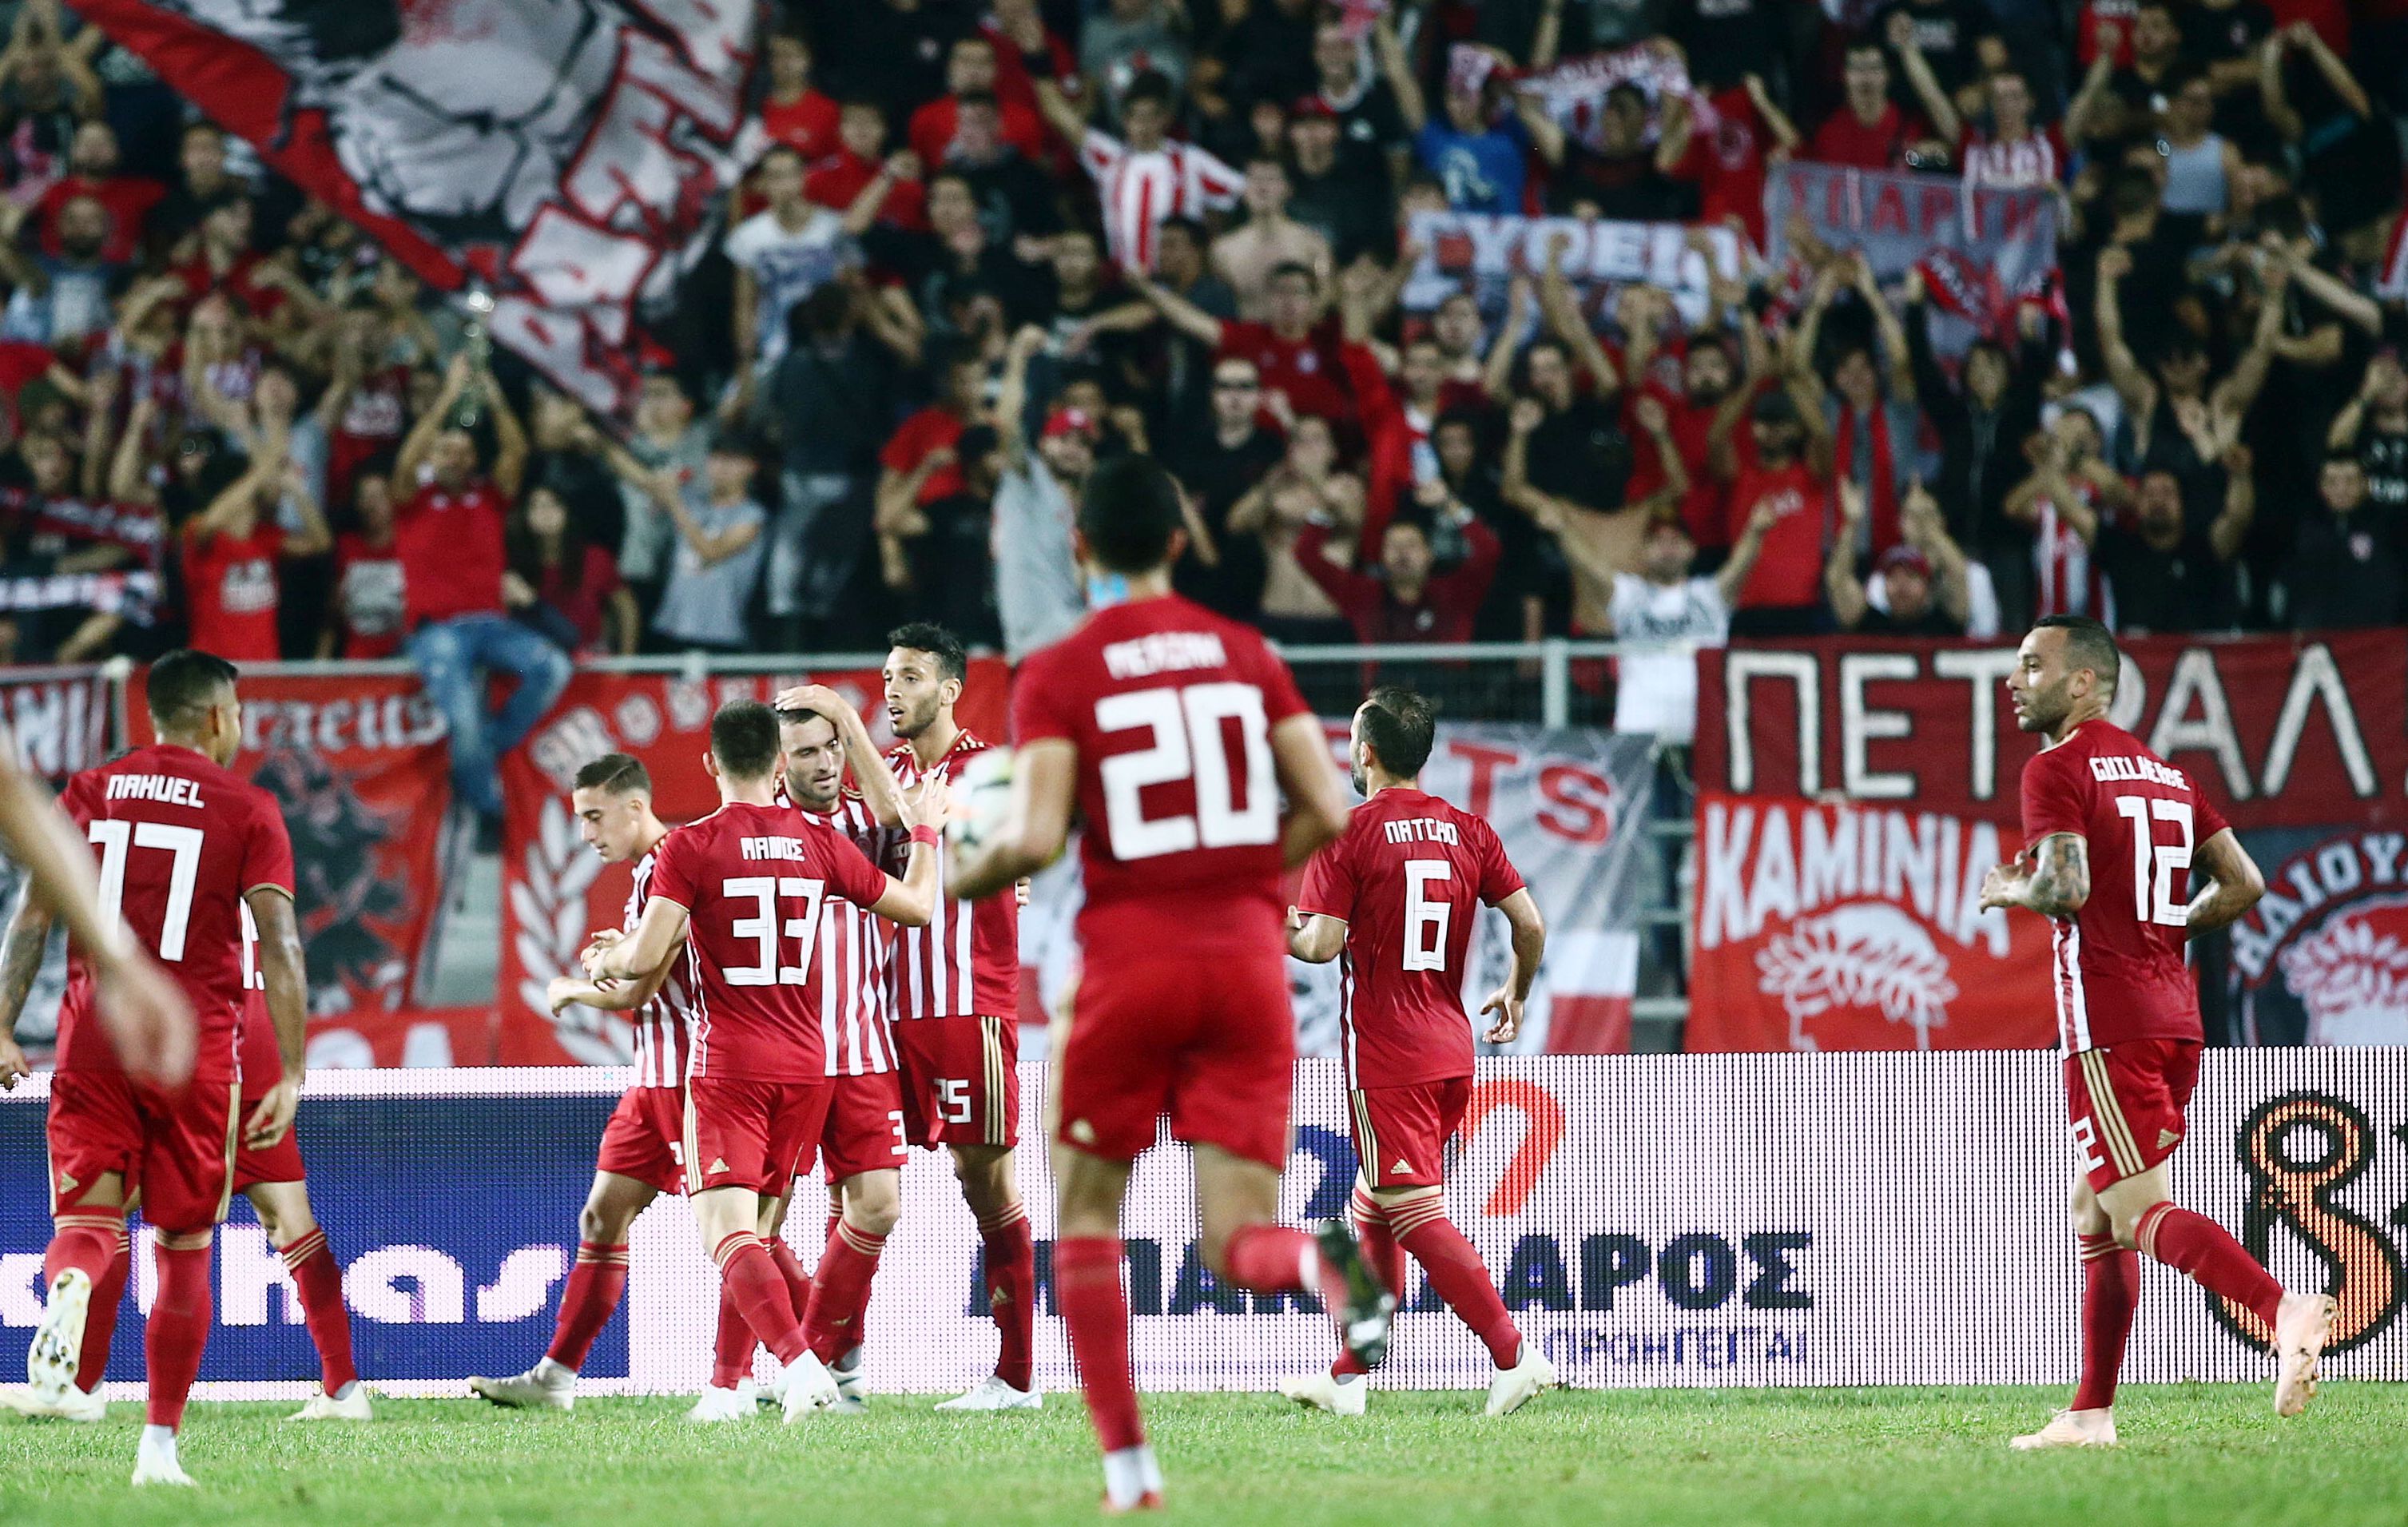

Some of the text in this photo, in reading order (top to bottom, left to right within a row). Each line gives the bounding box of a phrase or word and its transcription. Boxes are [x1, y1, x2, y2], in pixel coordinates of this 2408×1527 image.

[105, 773, 205, 809] NAHUEL
[1094, 681, 1280, 861] 20
[1383, 817, 1460, 847] NATCHO
[88, 817, 205, 963] 17
[1402, 858, 1452, 972] 6
[1699, 801, 2012, 960] KAMINIA
[2114, 795, 2195, 926] 12
[721, 876, 826, 987] 33
